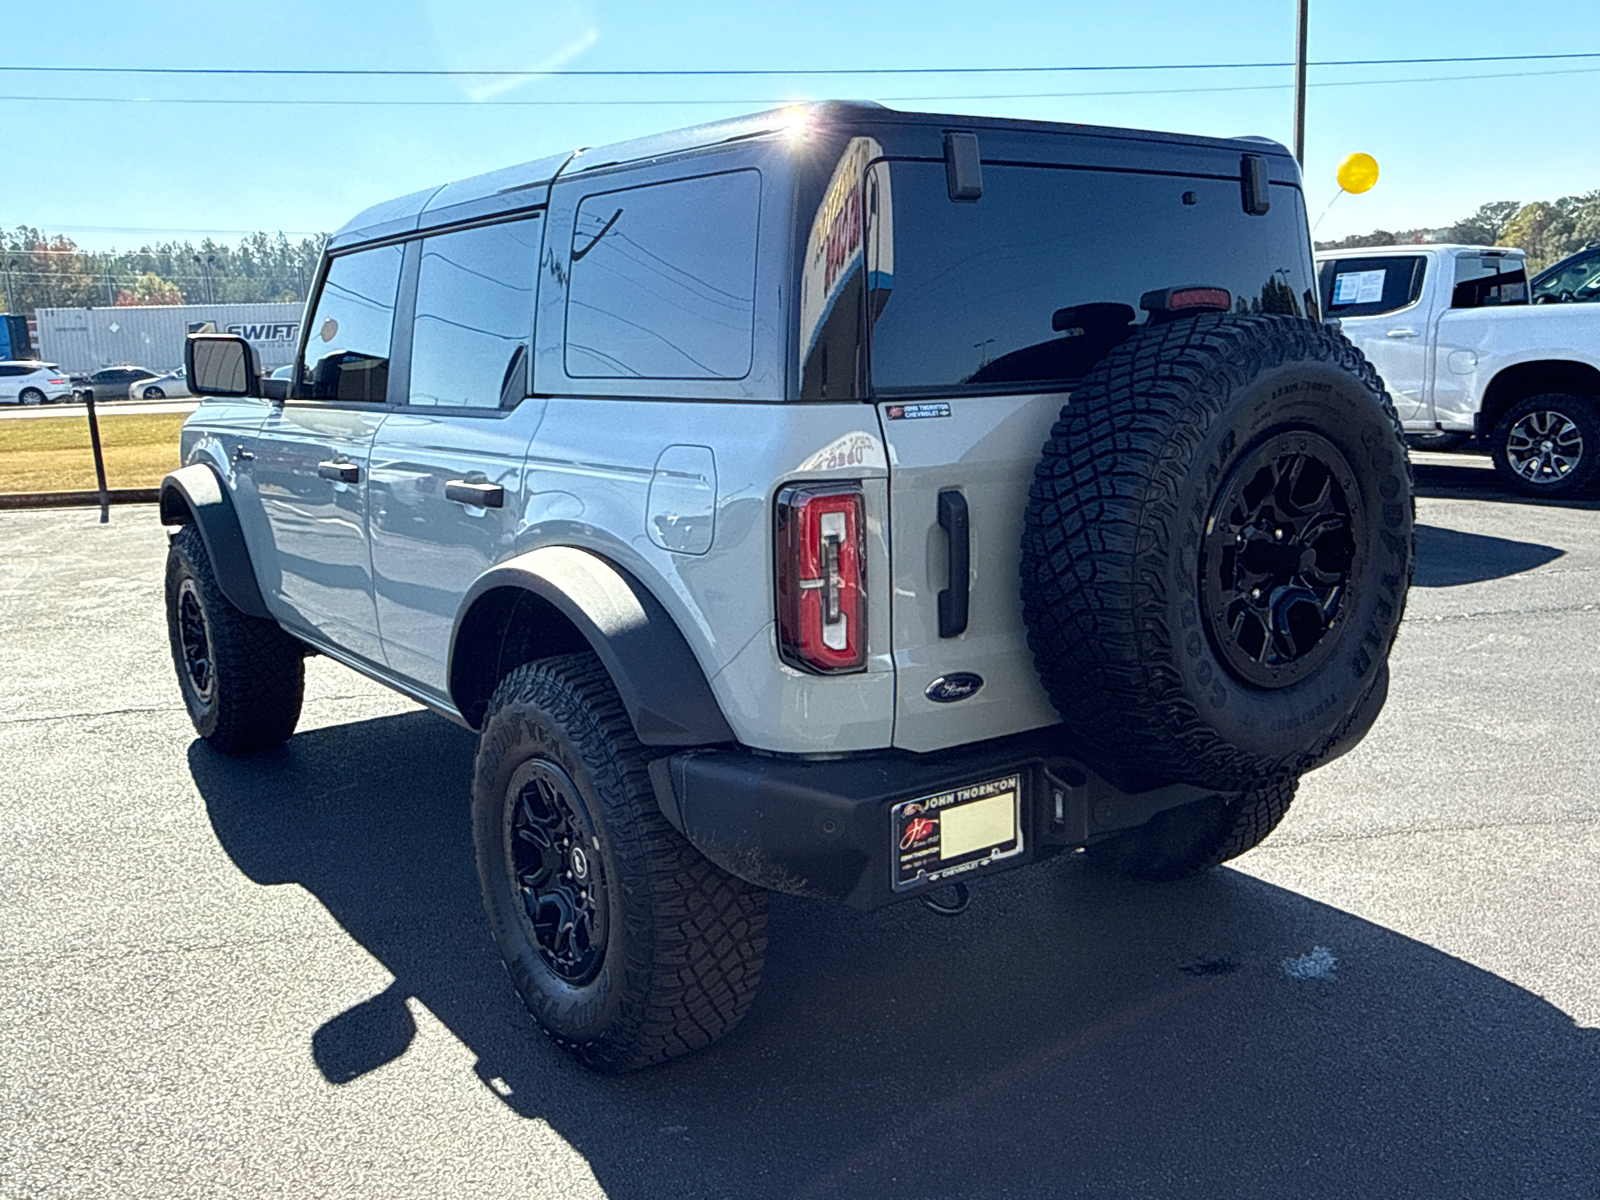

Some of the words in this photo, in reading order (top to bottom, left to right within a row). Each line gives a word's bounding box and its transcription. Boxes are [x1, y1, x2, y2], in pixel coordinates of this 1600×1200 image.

[227, 323, 299, 340] SWIFT
[940, 681, 972, 697] Ford
[924, 794, 955, 810] JOHN
[956, 777, 1016, 801] THORNTON
[942, 861, 979, 878] CHEVROLET
